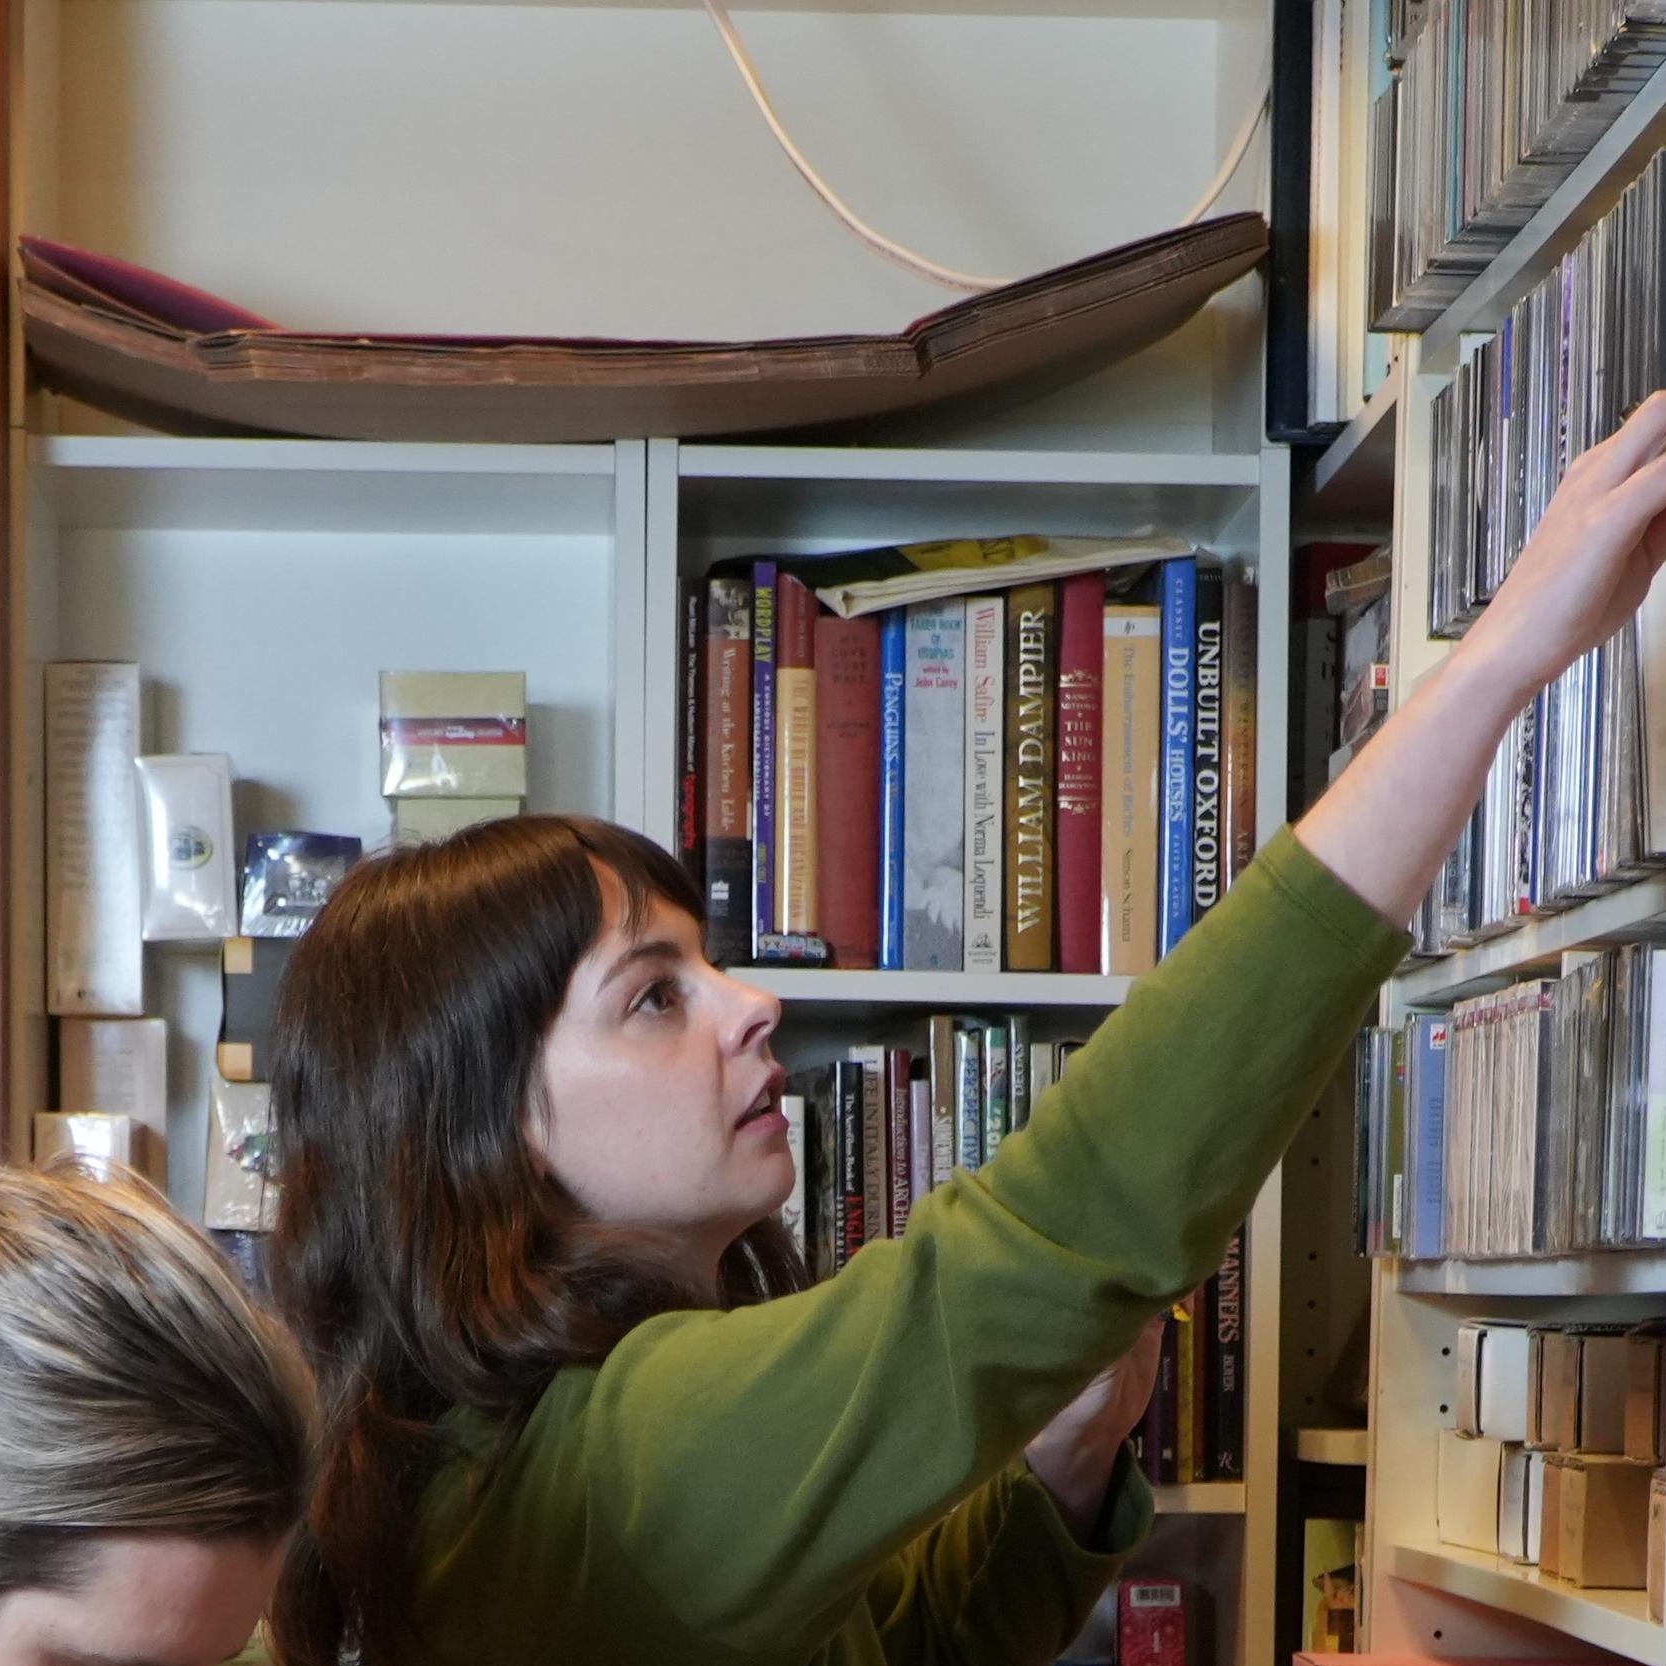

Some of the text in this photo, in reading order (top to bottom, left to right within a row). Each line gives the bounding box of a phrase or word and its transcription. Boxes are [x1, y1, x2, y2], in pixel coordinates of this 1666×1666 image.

[755, 587, 773, 663] WORDPLAY
[718, 649, 736, 697] Writing
[1123, 645, 1136, 670] The
[915, 676, 958, 690] John Carey
[1168, 577, 1189, 822] CLASSIC DOLLS' HOUSES
[720, 701, 735, 712] at
[720, 718, 736, 739] the
[885, 672, 903, 762] PENGUINS
[1065, 721, 1092, 732] THE
[969, 606, 996, 919] William Safire In Love with Norma Loquendi
[1061, 751, 1096, 763] KING
[1064, 735, 1094, 748] SUN
[1195, 621, 1220, 907] UNBUILT OXFORD
[720, 744, 736, 793] Kitchen
[1017, 610, 1045, 933] WILLIAM DAMPIER
[1123, 794, 1136, 837] Riches
[1121, 847, 1135, 891] Simon
[1122, 899, 1135, 942] Schama
[1012, 1043, 1027, 1096] DEGAS
[846, 1094, 855, 1111] The
[864, 1061, 879, 1179] LIFE IN ITALY
[962, 1057, 980, 1174] PERSPECTIVE
[893, 1087, 909, 1176] Introduction to
[846, 1157, 855, 1178] Book
[846, 1180, 855, 1191] of
[1216, 1238, 1240, 1343] MANNERS
